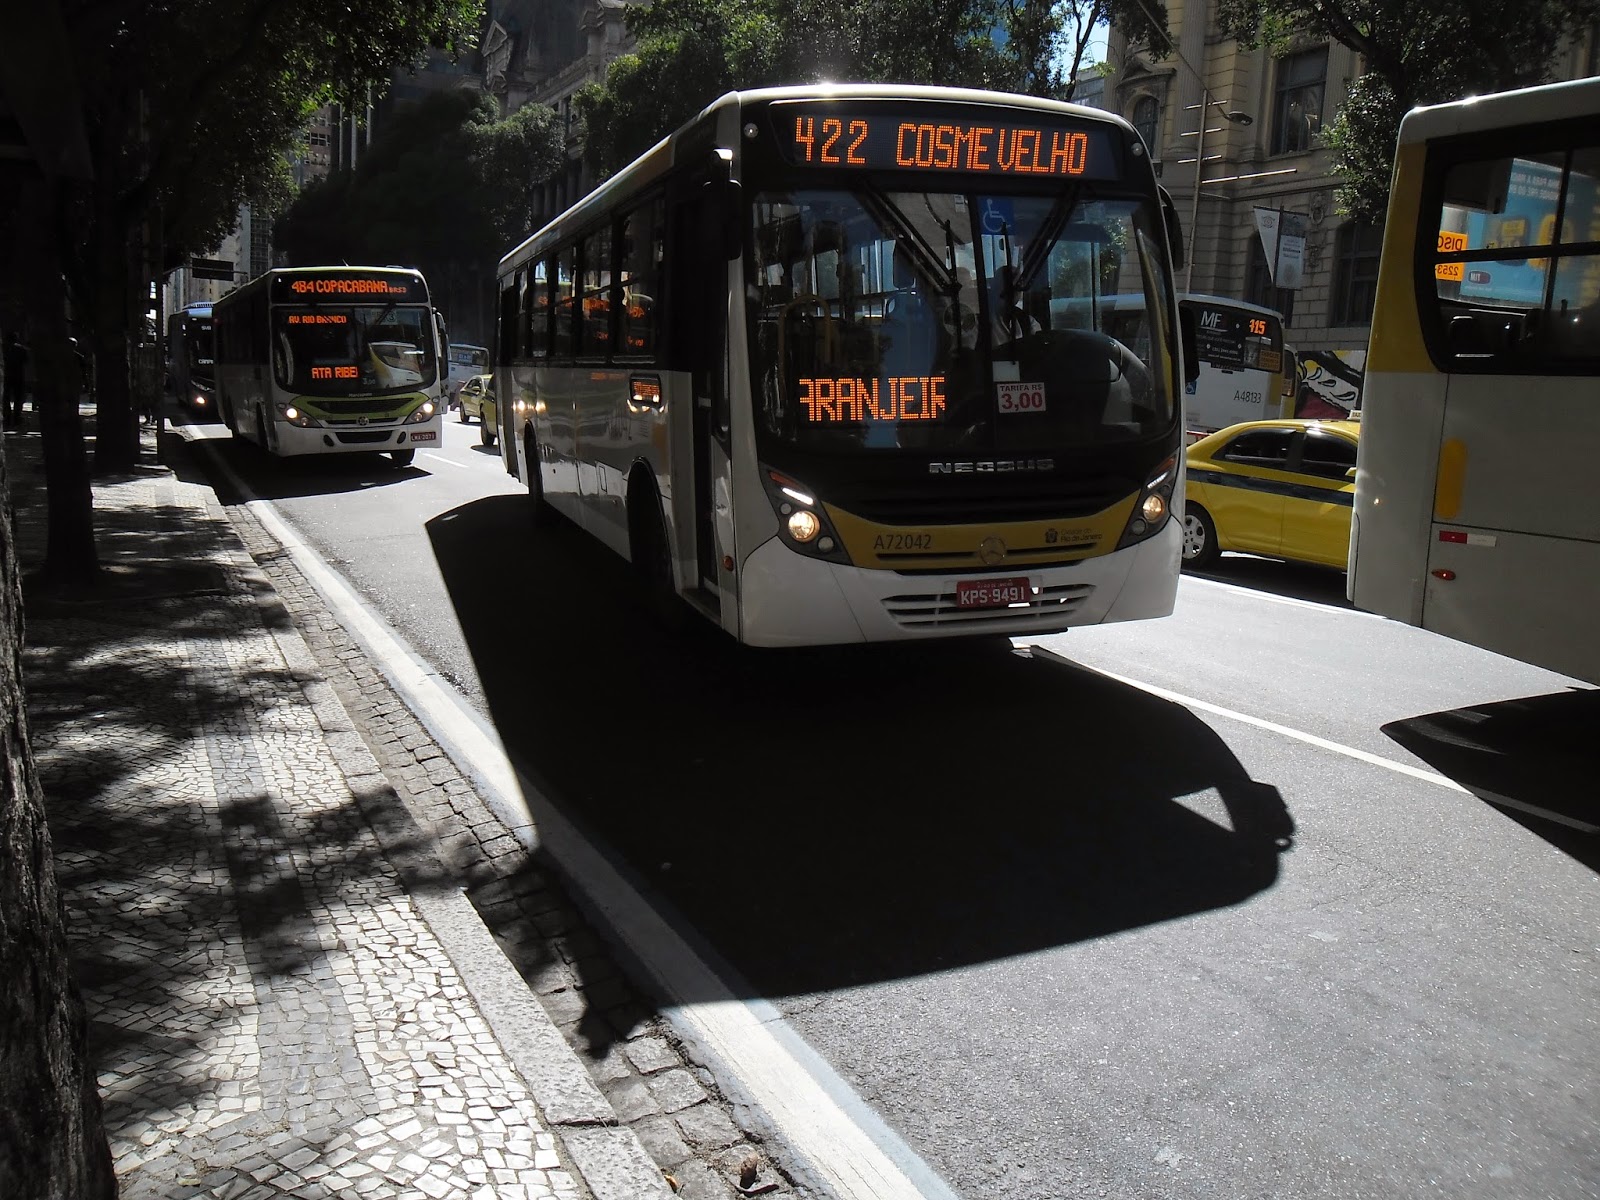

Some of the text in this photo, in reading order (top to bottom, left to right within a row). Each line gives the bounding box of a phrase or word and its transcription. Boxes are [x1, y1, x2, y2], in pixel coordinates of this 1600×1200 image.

[796, 117, 1088, 174] 422 COSME VELHO
[291, 281, 315, 293] 484
[316, 280, 388, 293] COPACABANA
[312, 367, 332, 378] ATA
[1001, 392, 1043, 411] 3,00
[929, 458, 1055, 474] NEOBUS
[874, 534, 931, 550] A72042
